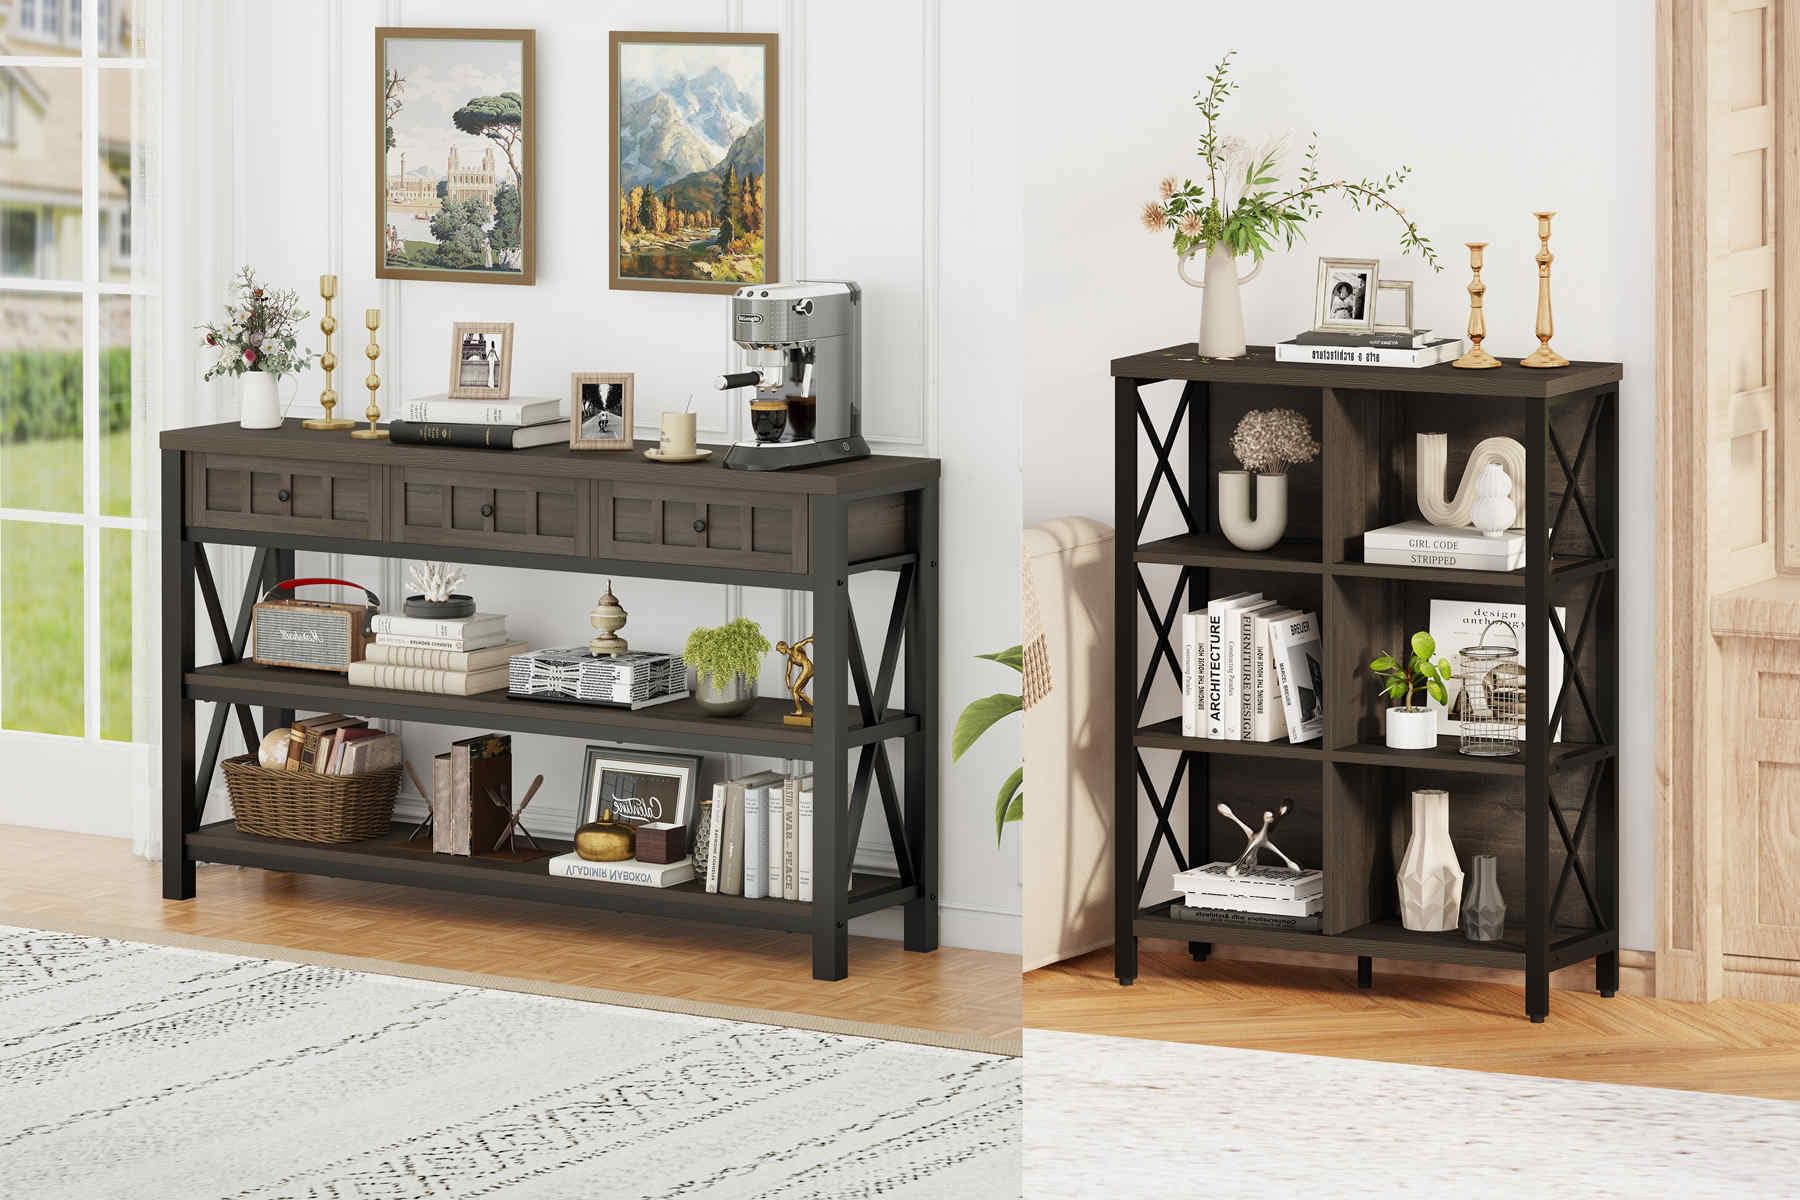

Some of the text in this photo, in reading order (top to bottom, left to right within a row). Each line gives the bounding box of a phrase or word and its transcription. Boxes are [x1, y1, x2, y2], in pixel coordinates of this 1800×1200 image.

[1408, 539, 1459, 551] GIRL CODE
[1410, 554, 1457, 566] STRIPPED
[1473, 608, 1517, 619] design
[1210, 615, 1221, 721] ARCHITECTURE
[1242, 616, 1252, 740] FURNITURE DESIGN
[785, 811, 793, 840] WAR
[785, 851, 793, 890] PEACE
